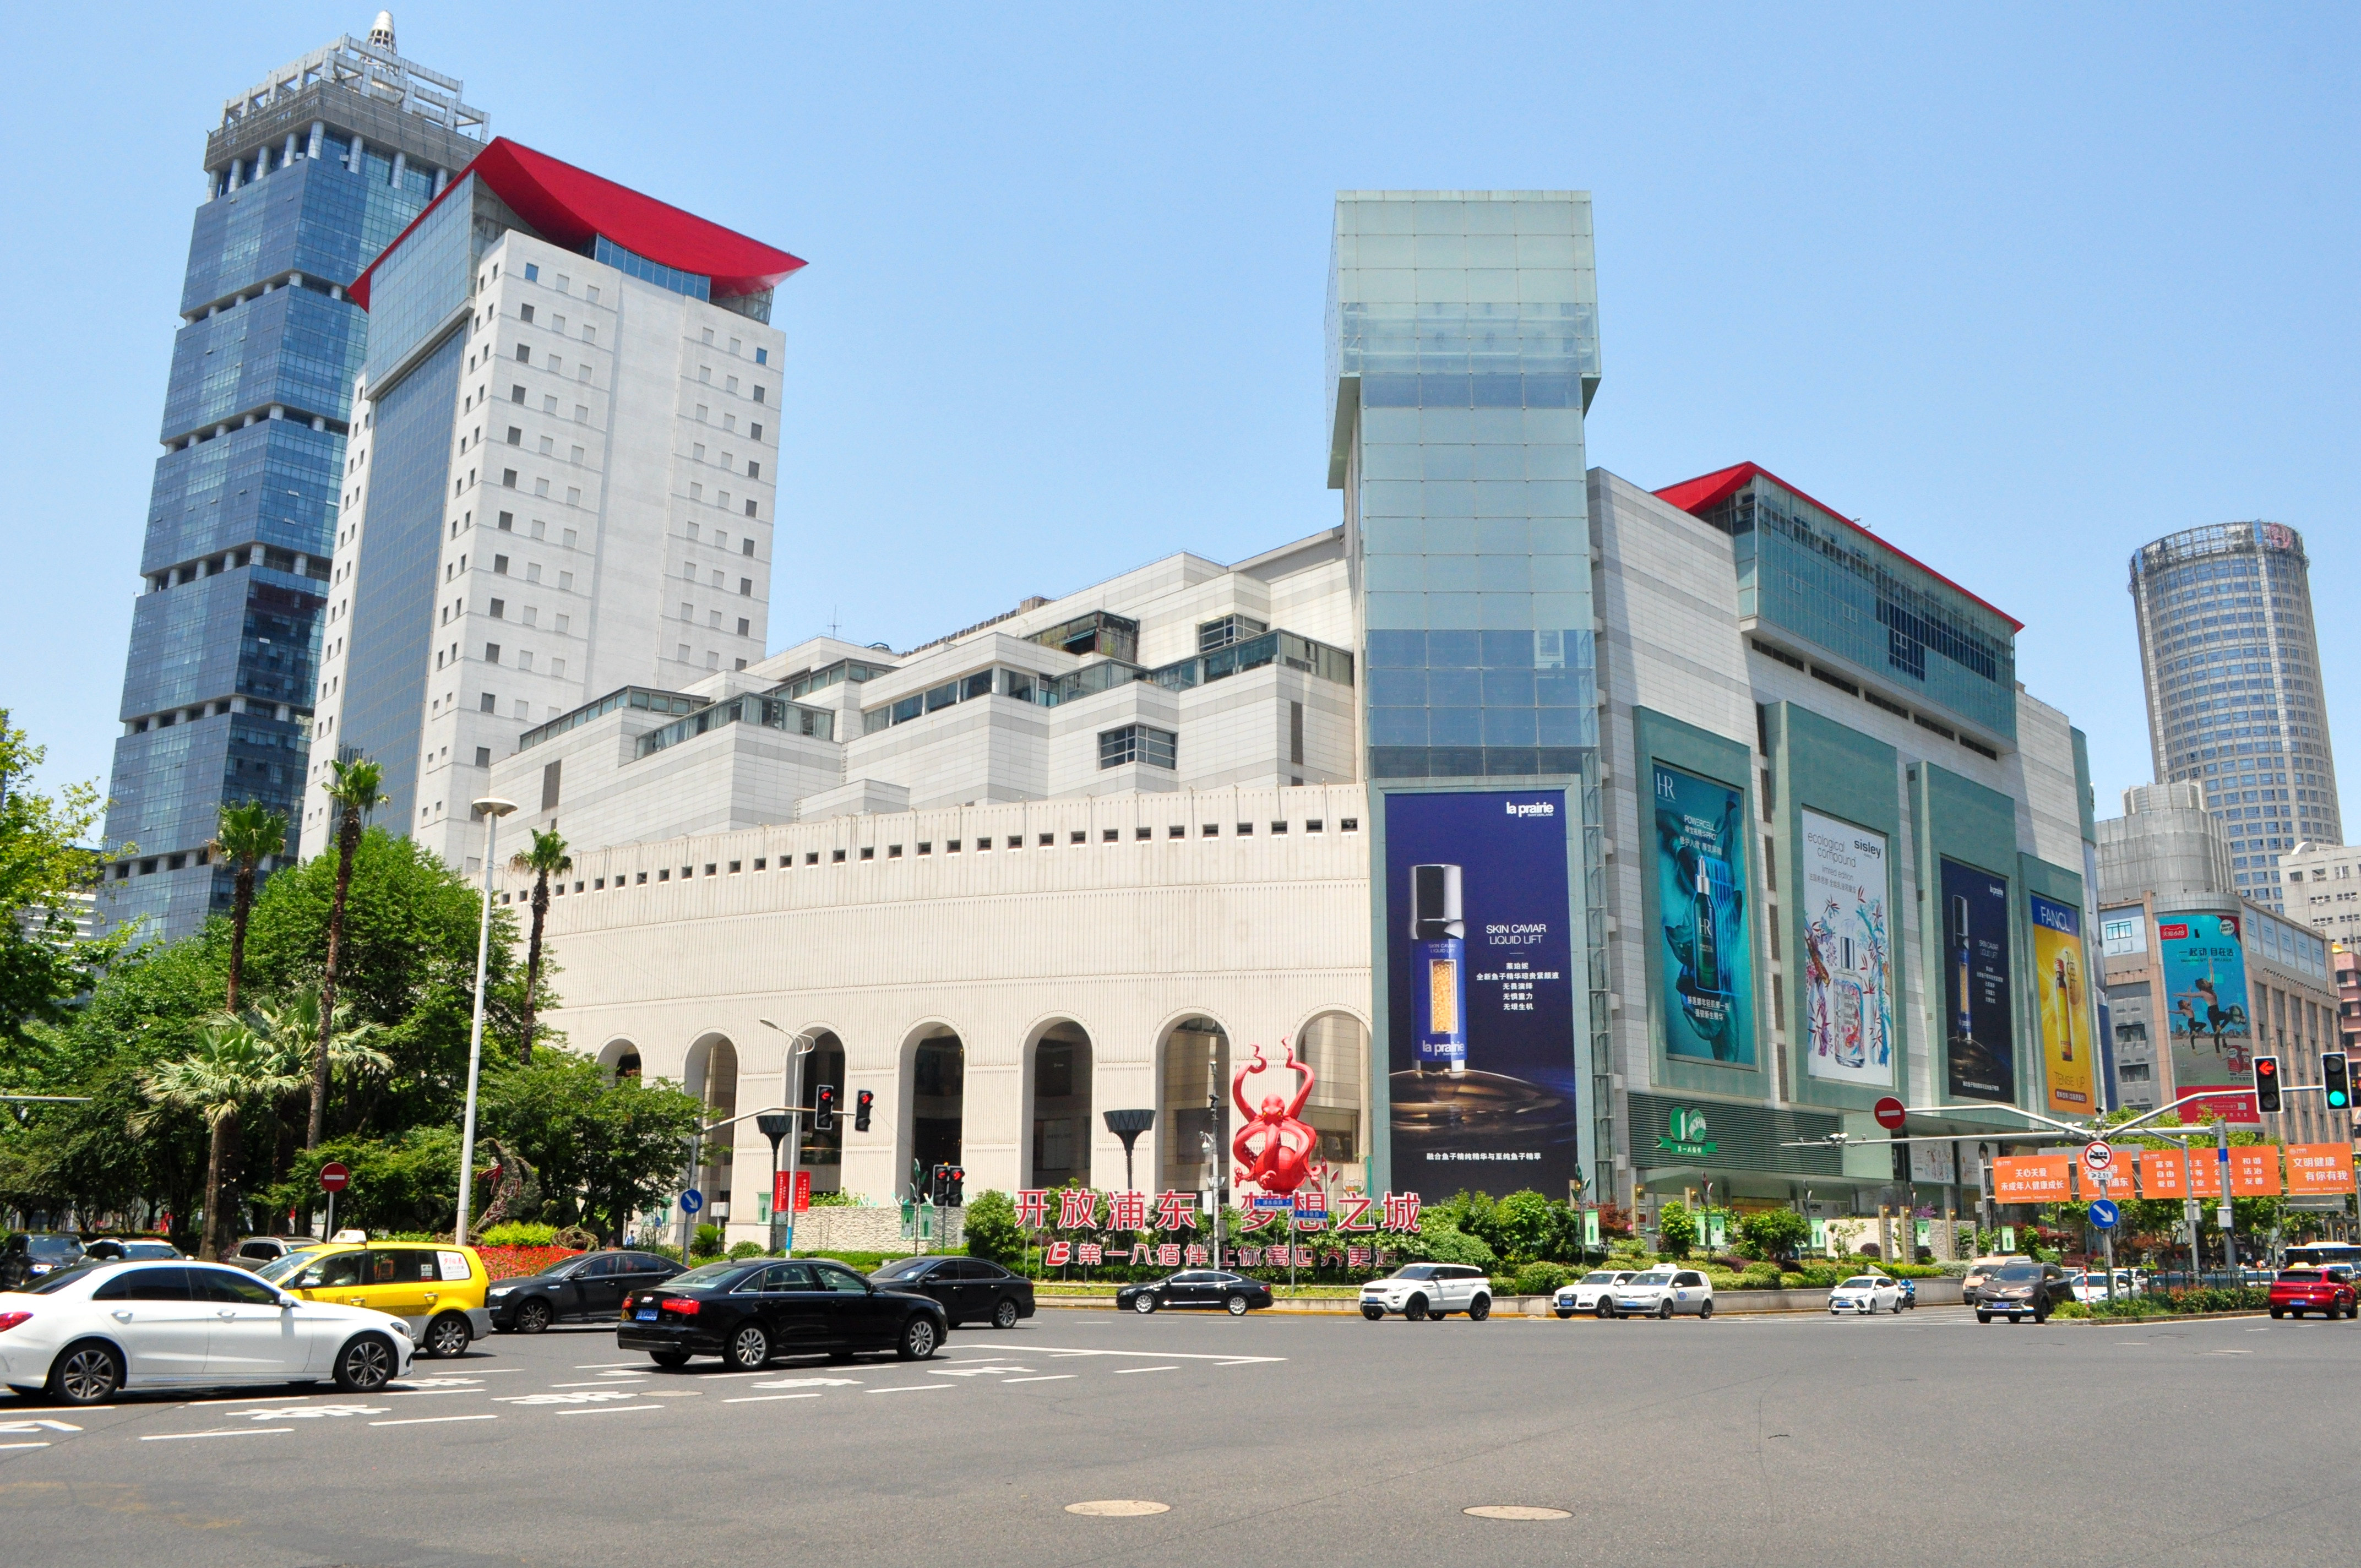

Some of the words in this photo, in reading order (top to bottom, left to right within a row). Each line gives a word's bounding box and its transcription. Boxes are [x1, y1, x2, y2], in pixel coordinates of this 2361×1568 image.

[1657, 772, 1676, 800] HR
[1506, 802, 1517, 814] la
[1518, 802, 1554, 817] prairie
[1808, 832, 1845, 853] ecological
[1854, 839, 1881, 859] sisley
[1818, 847, 1856, 868] compound
[2040, 906, 2070, 932] FANCL
[1486, 924, 1509, 934] SKIN
[1511, 924, 1547, 934] CAVIAR
[1699, 917, 1712, 938] HR
[1489, 935, 1521, 945] LIQUID
[1524, 934, 1543, 944] LIFT
[1422, 1040, 1432, 1052] la
[1434, 1040, 1465, 1056] prairie
[2054, 1071, 2075, 1086] TENSE
[2077, 1076, 2085, 1088] UP
[2292, 1156, 2335, 1168] 文明健康
[2015, 1167, 2047, 1178] 关心关爱
[2243, 1167, 2262, 1175] 法治
[2305, 1170, 2348, 1182] 有你有我
[2000, 1179, 2065, 1191] 未成年人健康成长
[2244, 1177, 2264, 1185] 友善
